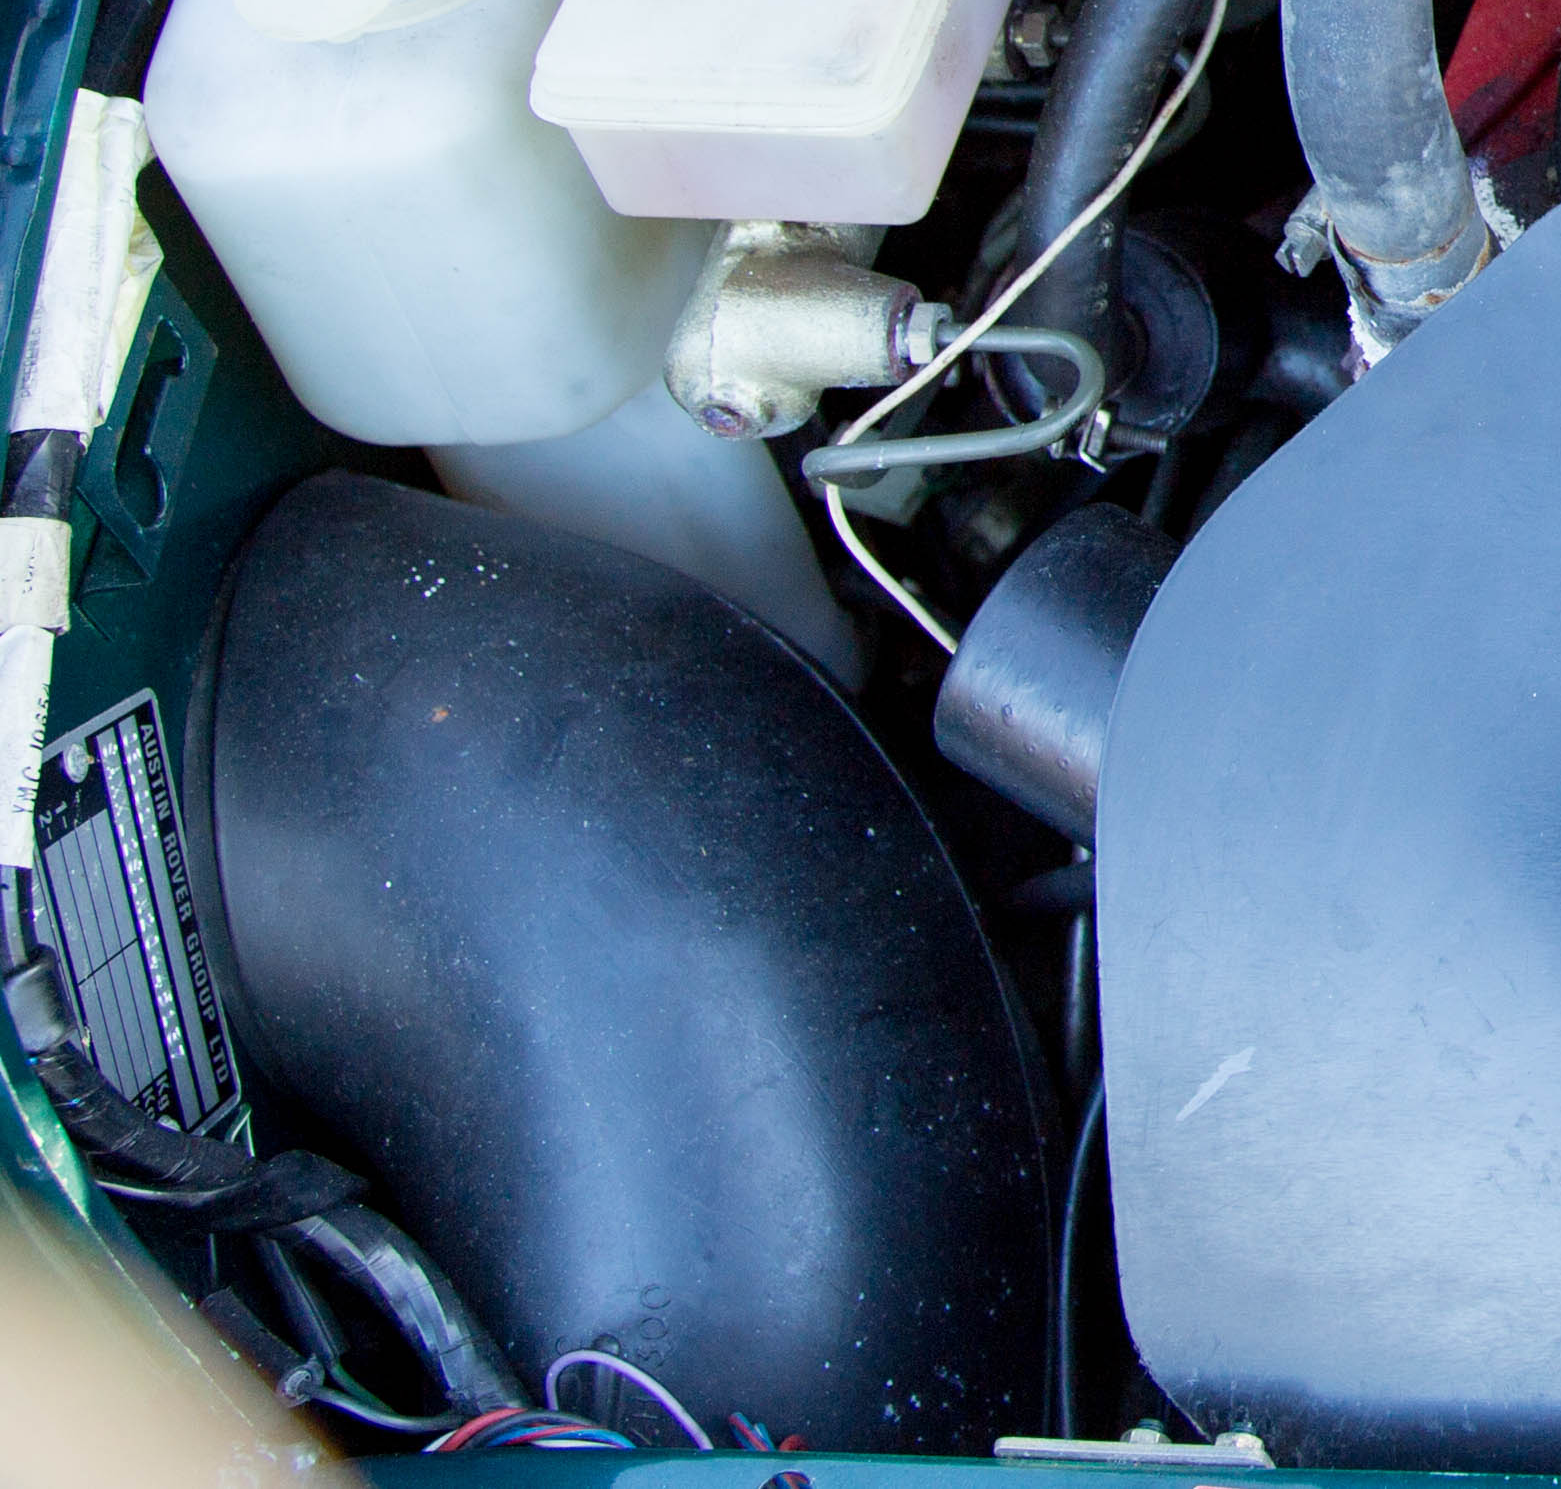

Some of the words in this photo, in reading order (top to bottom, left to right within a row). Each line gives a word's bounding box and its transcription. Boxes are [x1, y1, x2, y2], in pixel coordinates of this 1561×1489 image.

[140, 724, 171, 822] AUSTIN
[163, 832, 193, 922] ROVER
[186, 932, 217, 1022] GROUP
[208, 1034, 230, 1083] LTD
[155, 1073, 170, 1111] Kg
